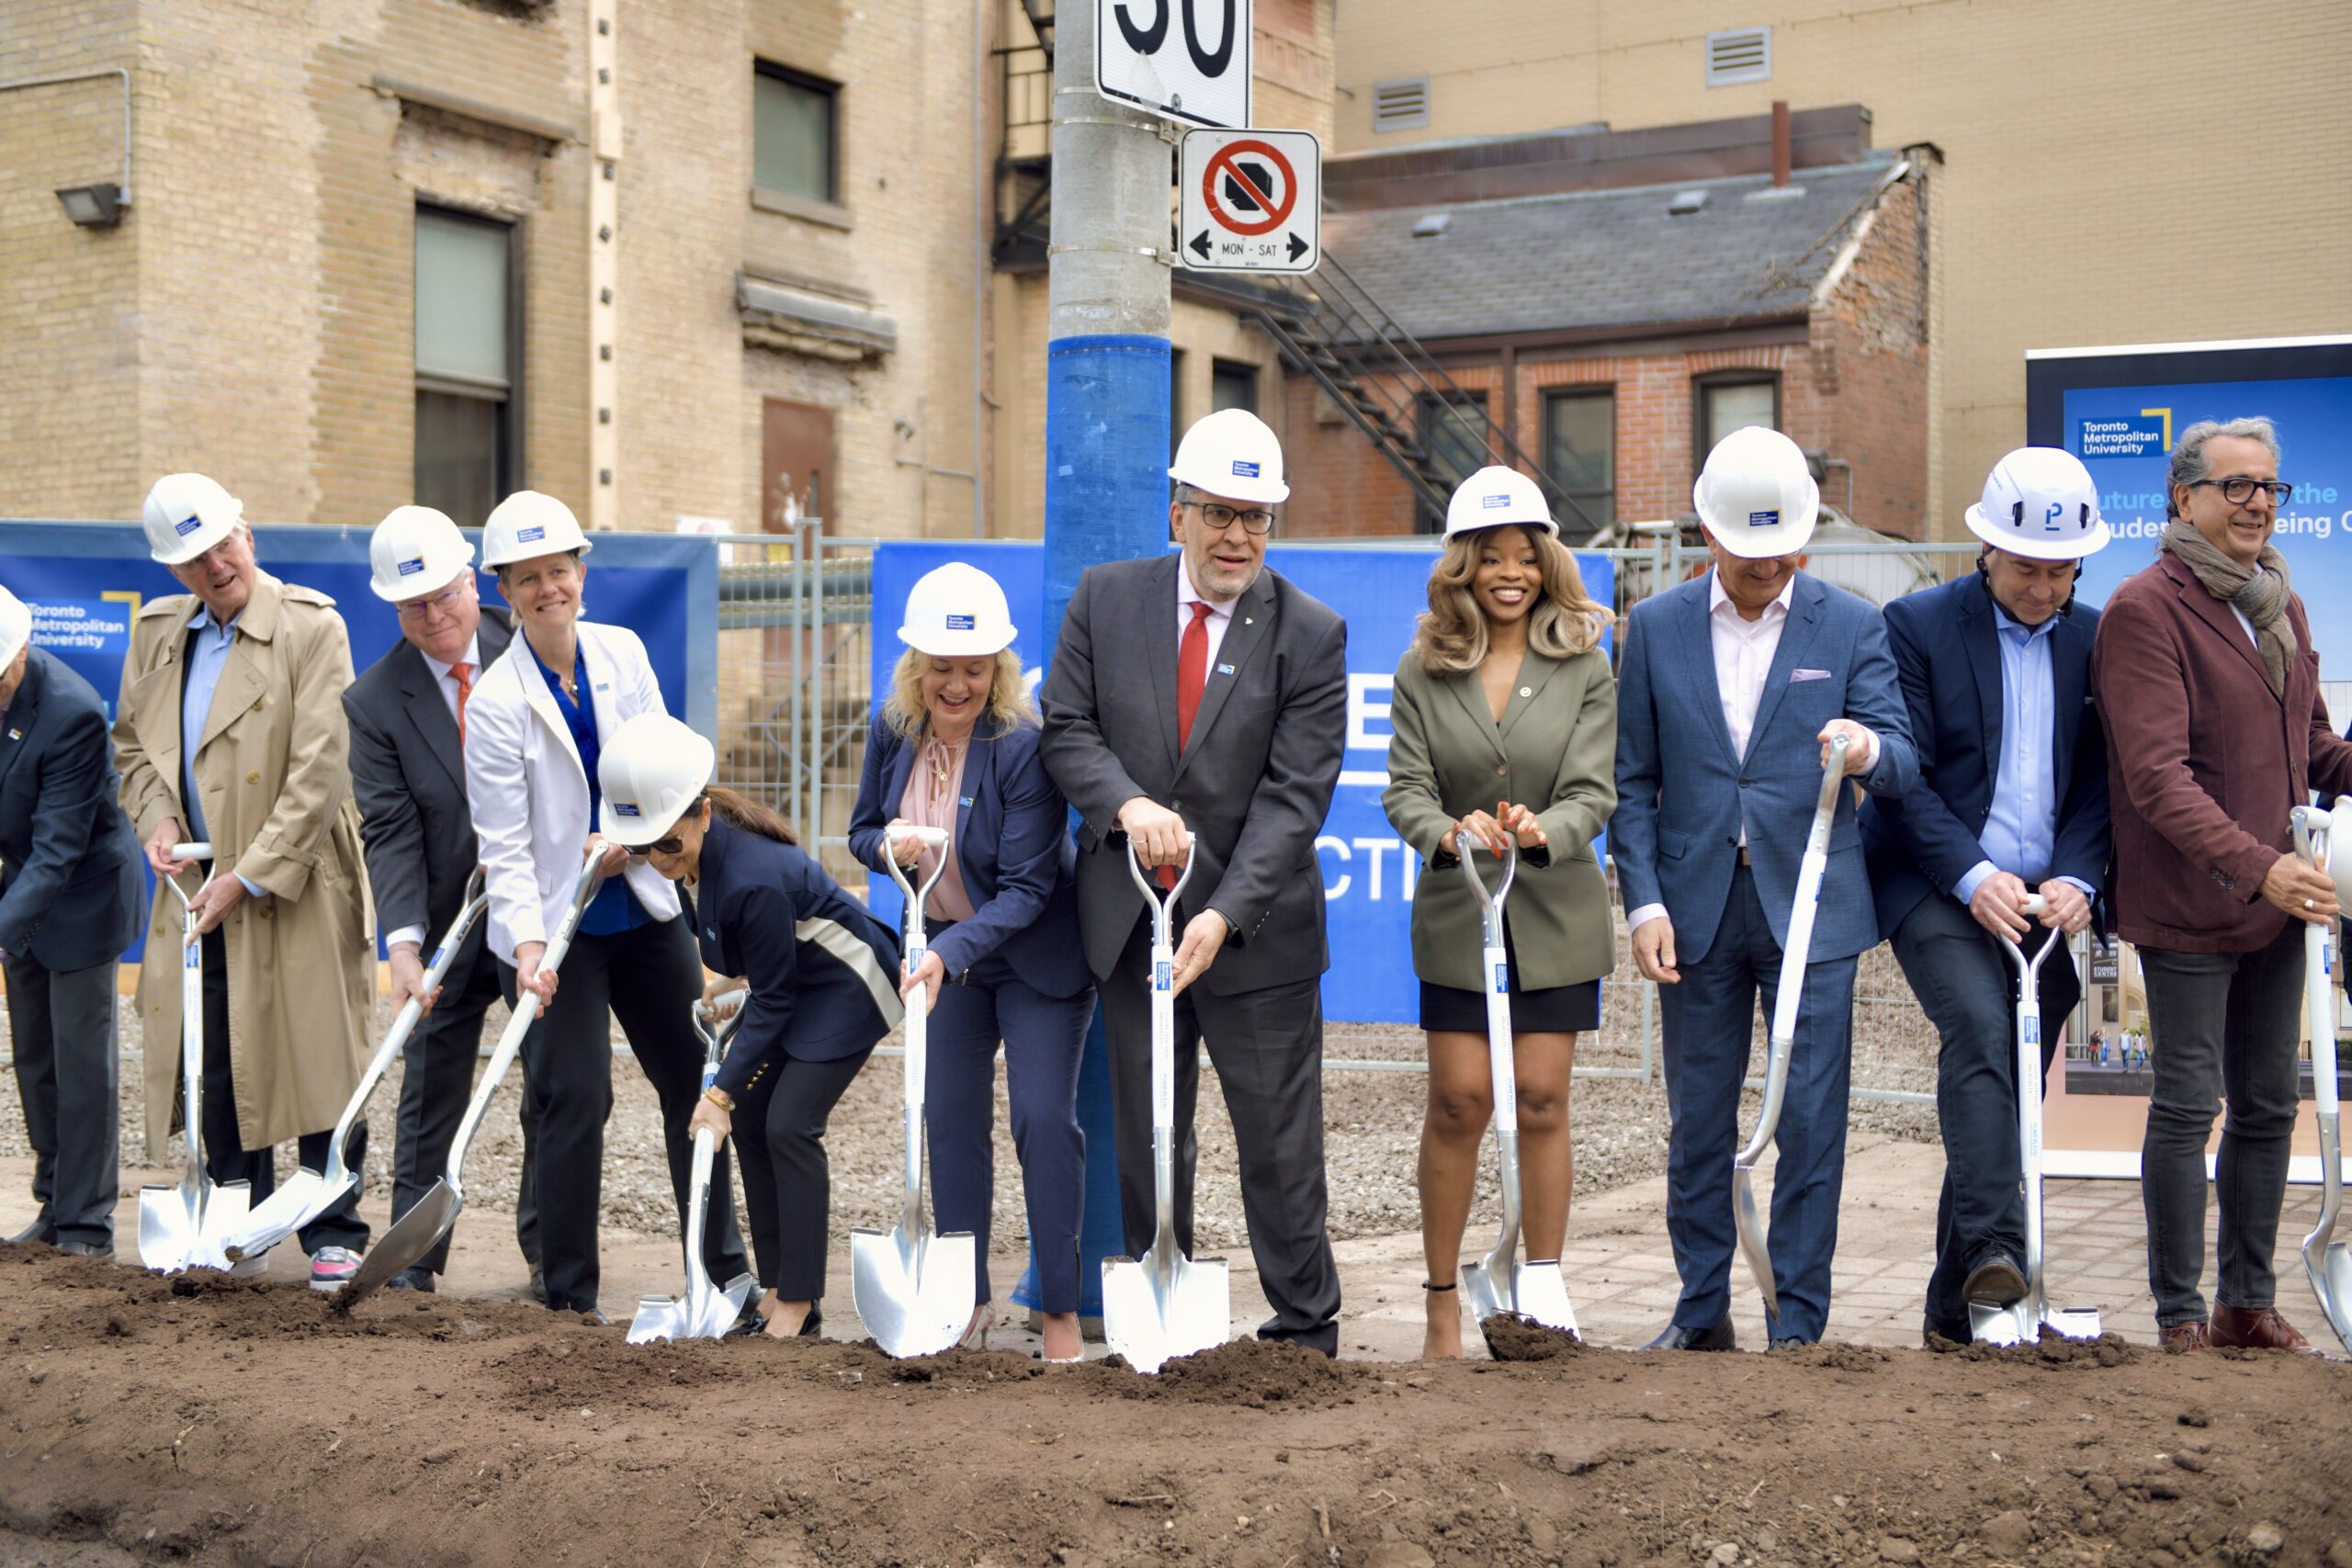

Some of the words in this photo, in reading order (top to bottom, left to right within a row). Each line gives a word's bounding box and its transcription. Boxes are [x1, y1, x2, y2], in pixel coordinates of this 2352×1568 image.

[1222, 243, 1244, 255] MON
[1259, 244, 1278, 256] SAT
[2084, 422, 2129, 433] Toronto
[2084, 431, 2159, 444] Metropolitan
[2084, 443, 2143, 456] University
[2098, 491, 2165, 511] uture
[2292, 482, 2338, 504] the
[2274, 512, 2332, 539] eing
[28, 603, 85, 618] Toronto
